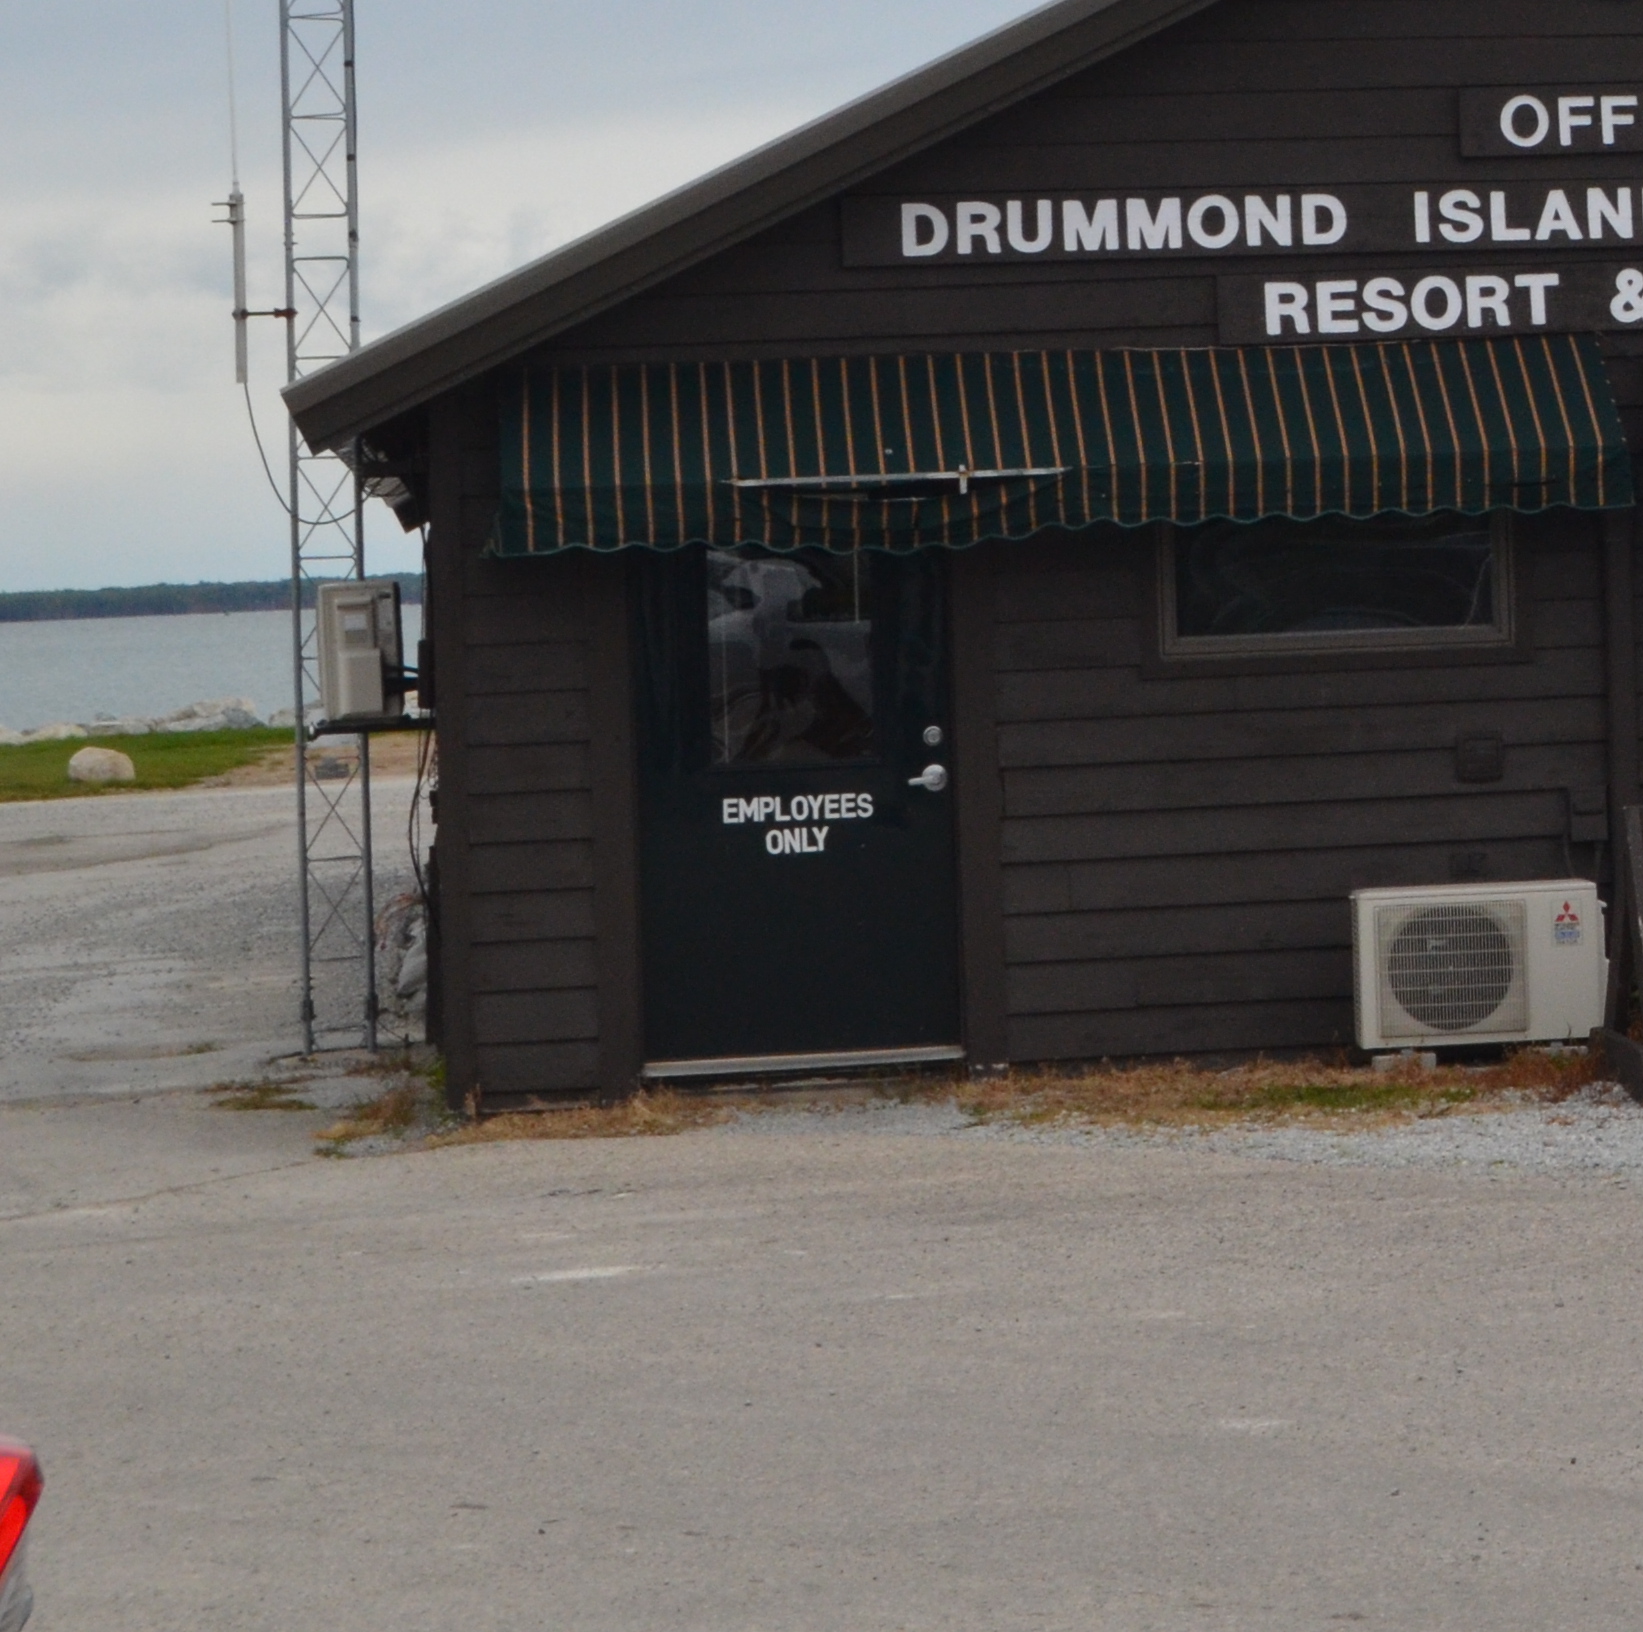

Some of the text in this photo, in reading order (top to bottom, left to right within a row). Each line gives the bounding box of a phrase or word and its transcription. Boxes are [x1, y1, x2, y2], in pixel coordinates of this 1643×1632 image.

[901, 193, 1348, 257] DRUMMOND
[1263, 272, 1560, 336] RESORT
[722, 793, 874, 824] EMPLOYEES
[765, 825, 829, 855] ONLY
